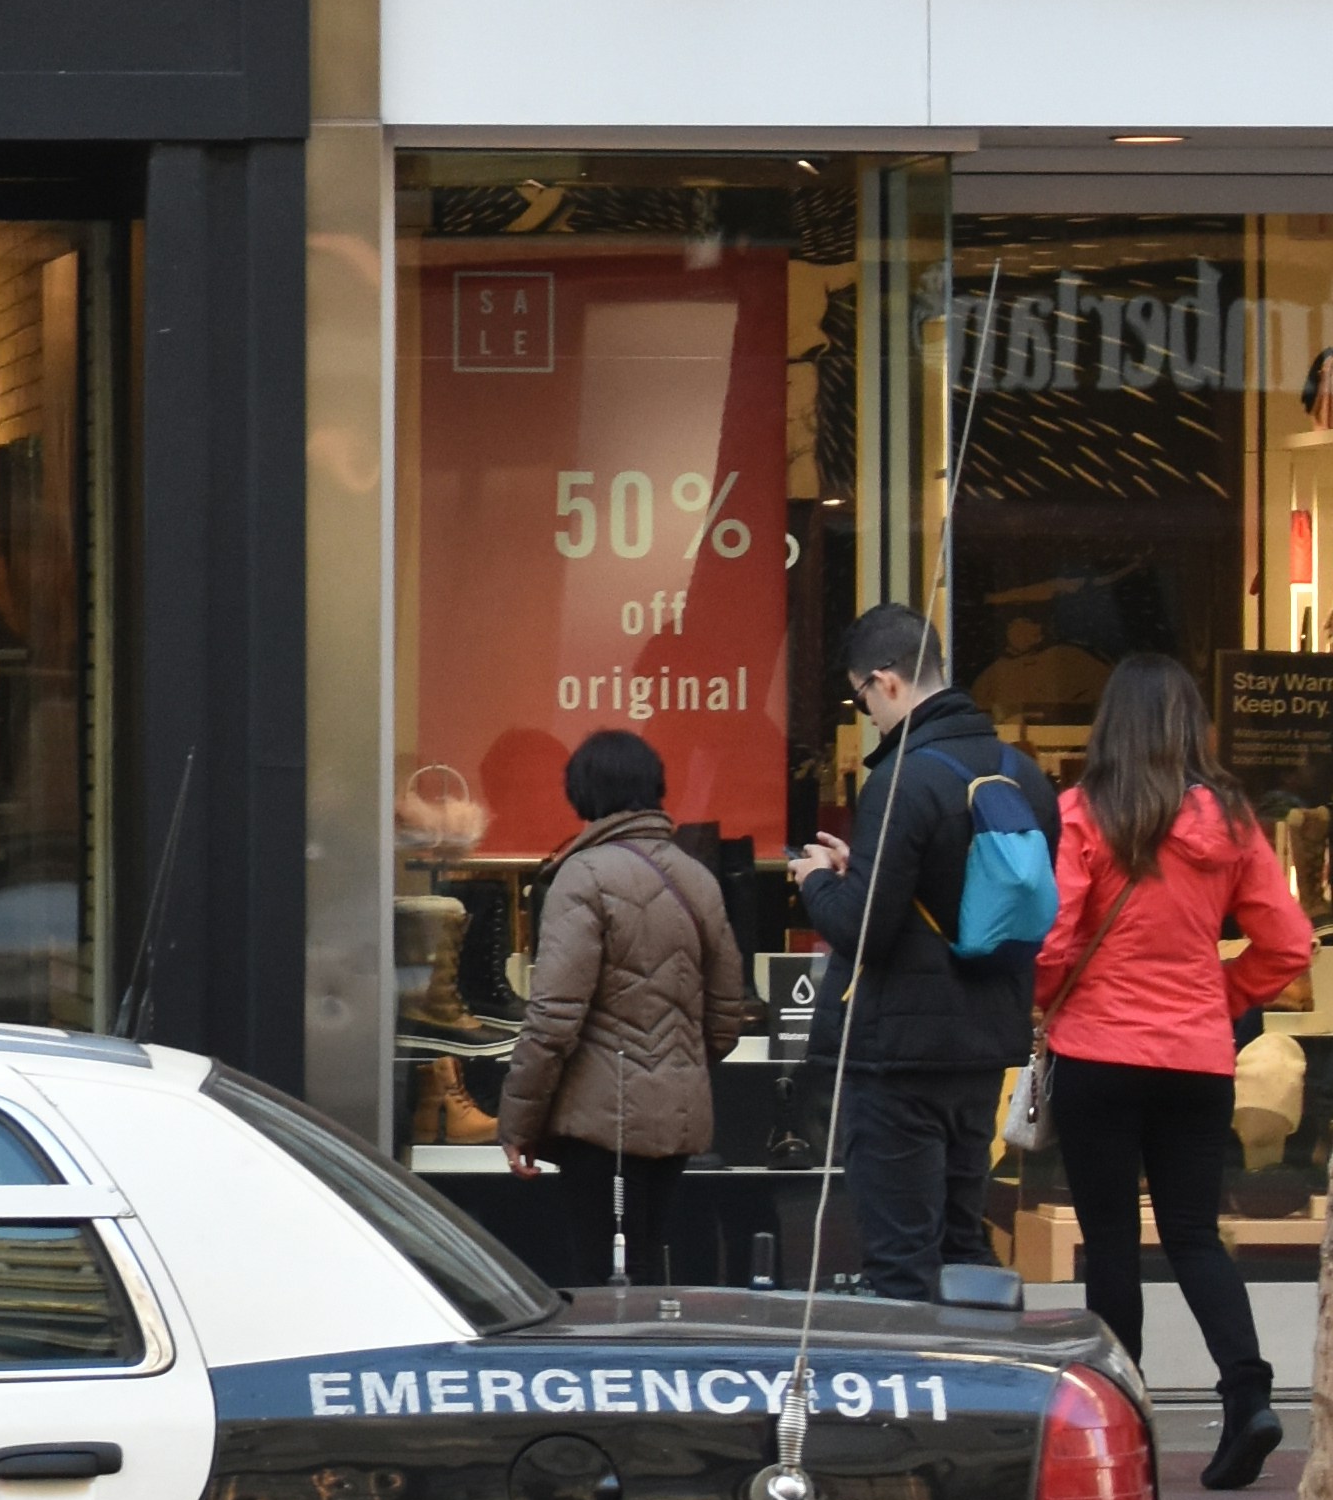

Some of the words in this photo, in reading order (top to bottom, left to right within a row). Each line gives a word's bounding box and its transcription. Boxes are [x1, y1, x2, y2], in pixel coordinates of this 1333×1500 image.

[554, 470, 751, 560] 50%
[621, 590, 687, 635] off
[558, 666, 748, 720] original
[1233, 672, 1279, 695] Stay
[1233, 695, 1286, 717] Keep
[1292, 696, 1331, 719] Dry.
[309, 1368, 792, 1417] EMERGENCY
[835, 1369, 949, 1422] 911
